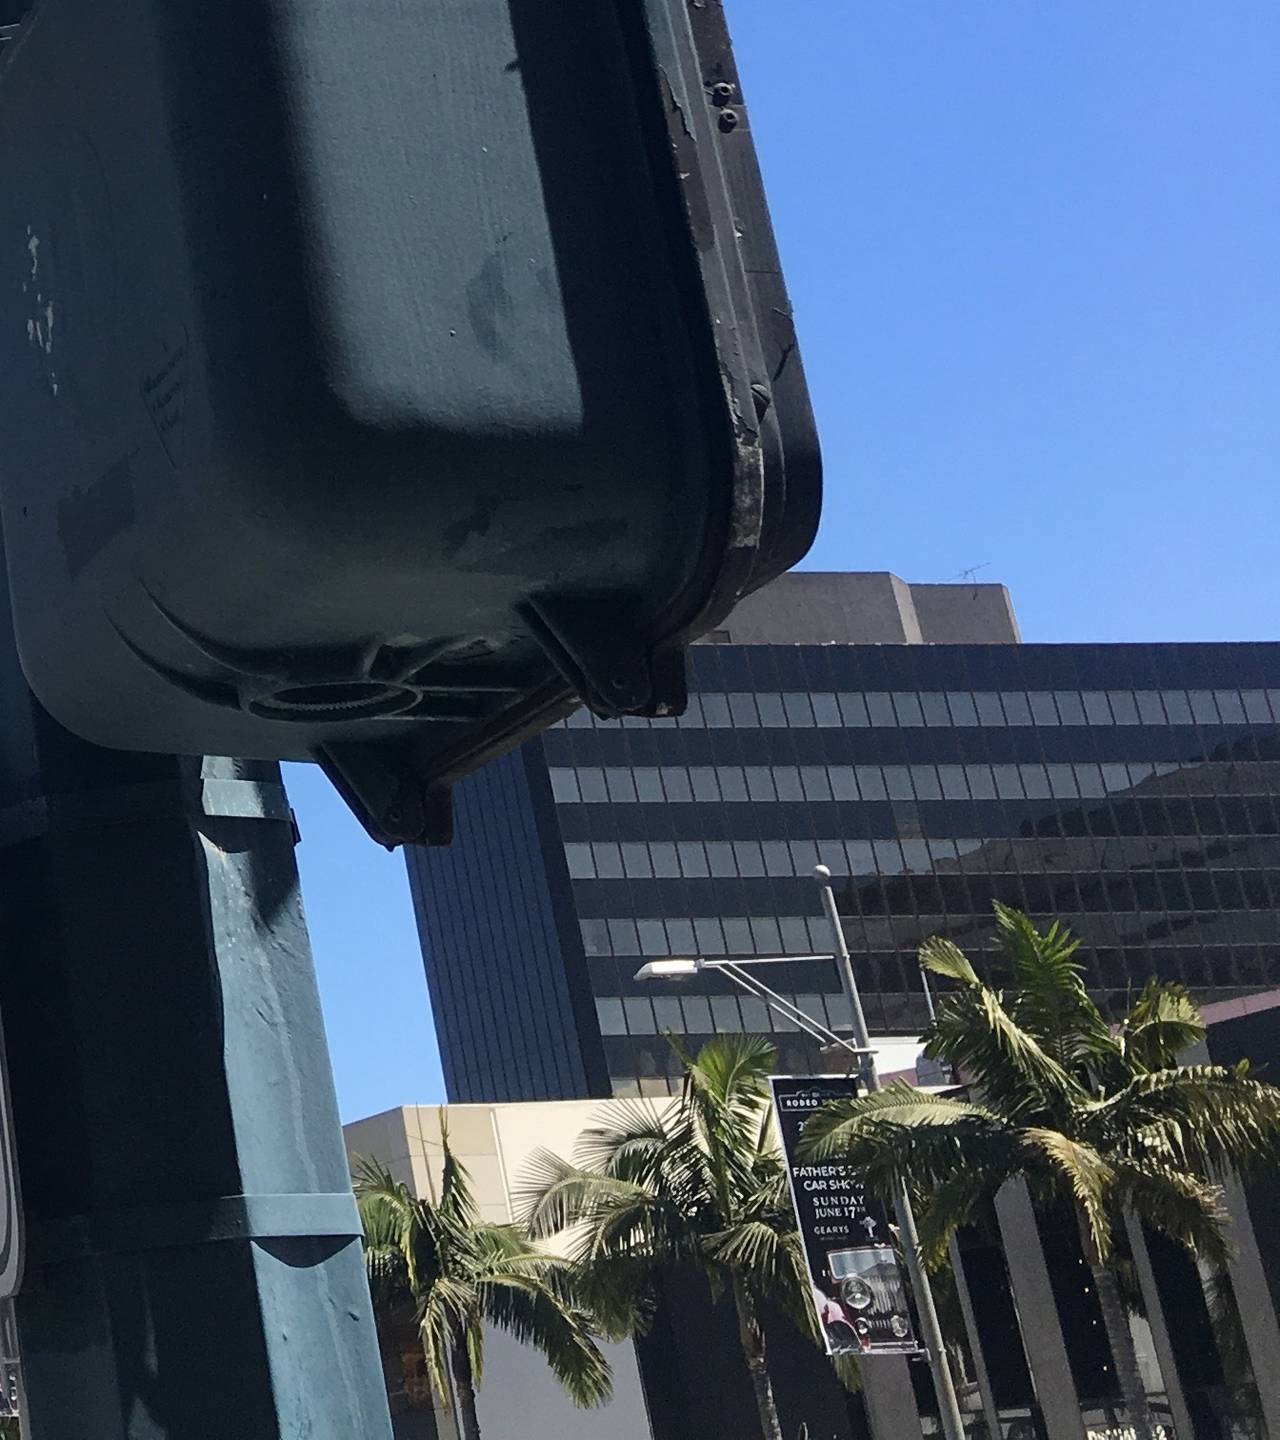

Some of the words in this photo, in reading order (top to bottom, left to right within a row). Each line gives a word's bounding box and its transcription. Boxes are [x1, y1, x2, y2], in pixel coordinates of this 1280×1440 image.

[803, 1180, 828, 1191] CAR
[812, 1195, 865, 1207] SUNDAY
[815, 1207, 842, 1220] JUNE
[814, 1225, 850, 1235] GEARYS
